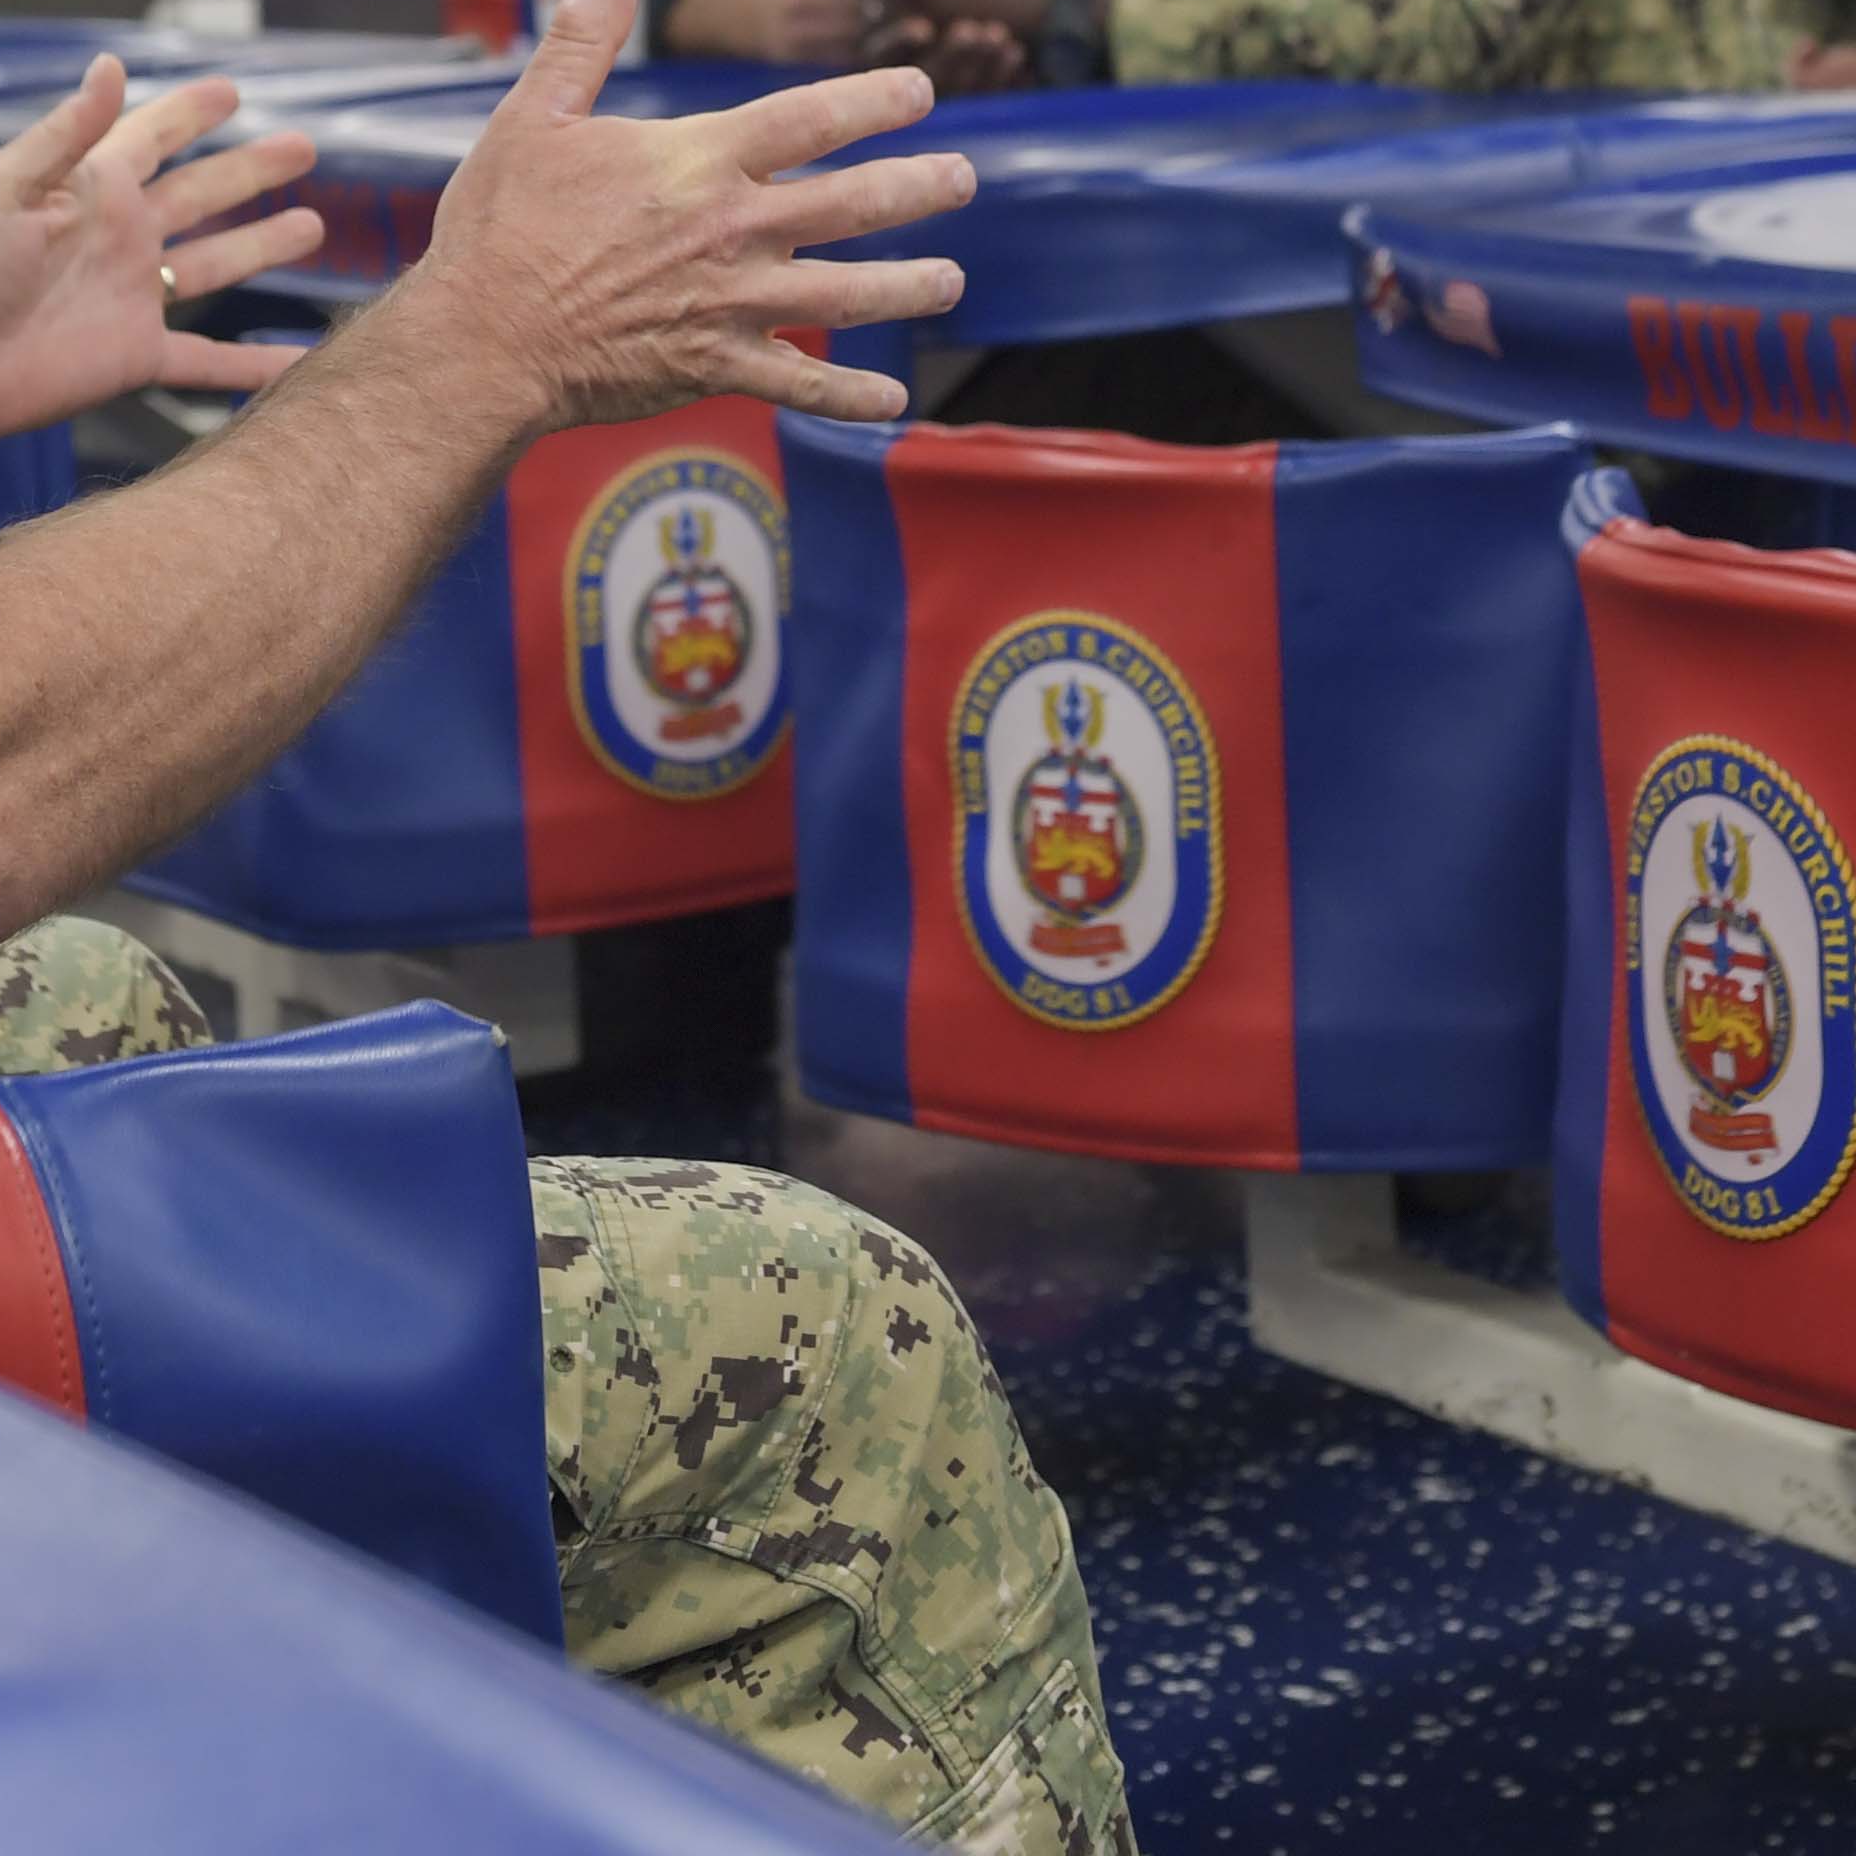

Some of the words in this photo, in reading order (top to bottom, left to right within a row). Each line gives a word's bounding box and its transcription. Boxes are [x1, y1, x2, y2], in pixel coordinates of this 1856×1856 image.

[1749, 777, 1849, 1018] CHURCHILL
[1684, 1164, 1741, 1218] DDG
[1745, 1187, 1782, 1221] 81
